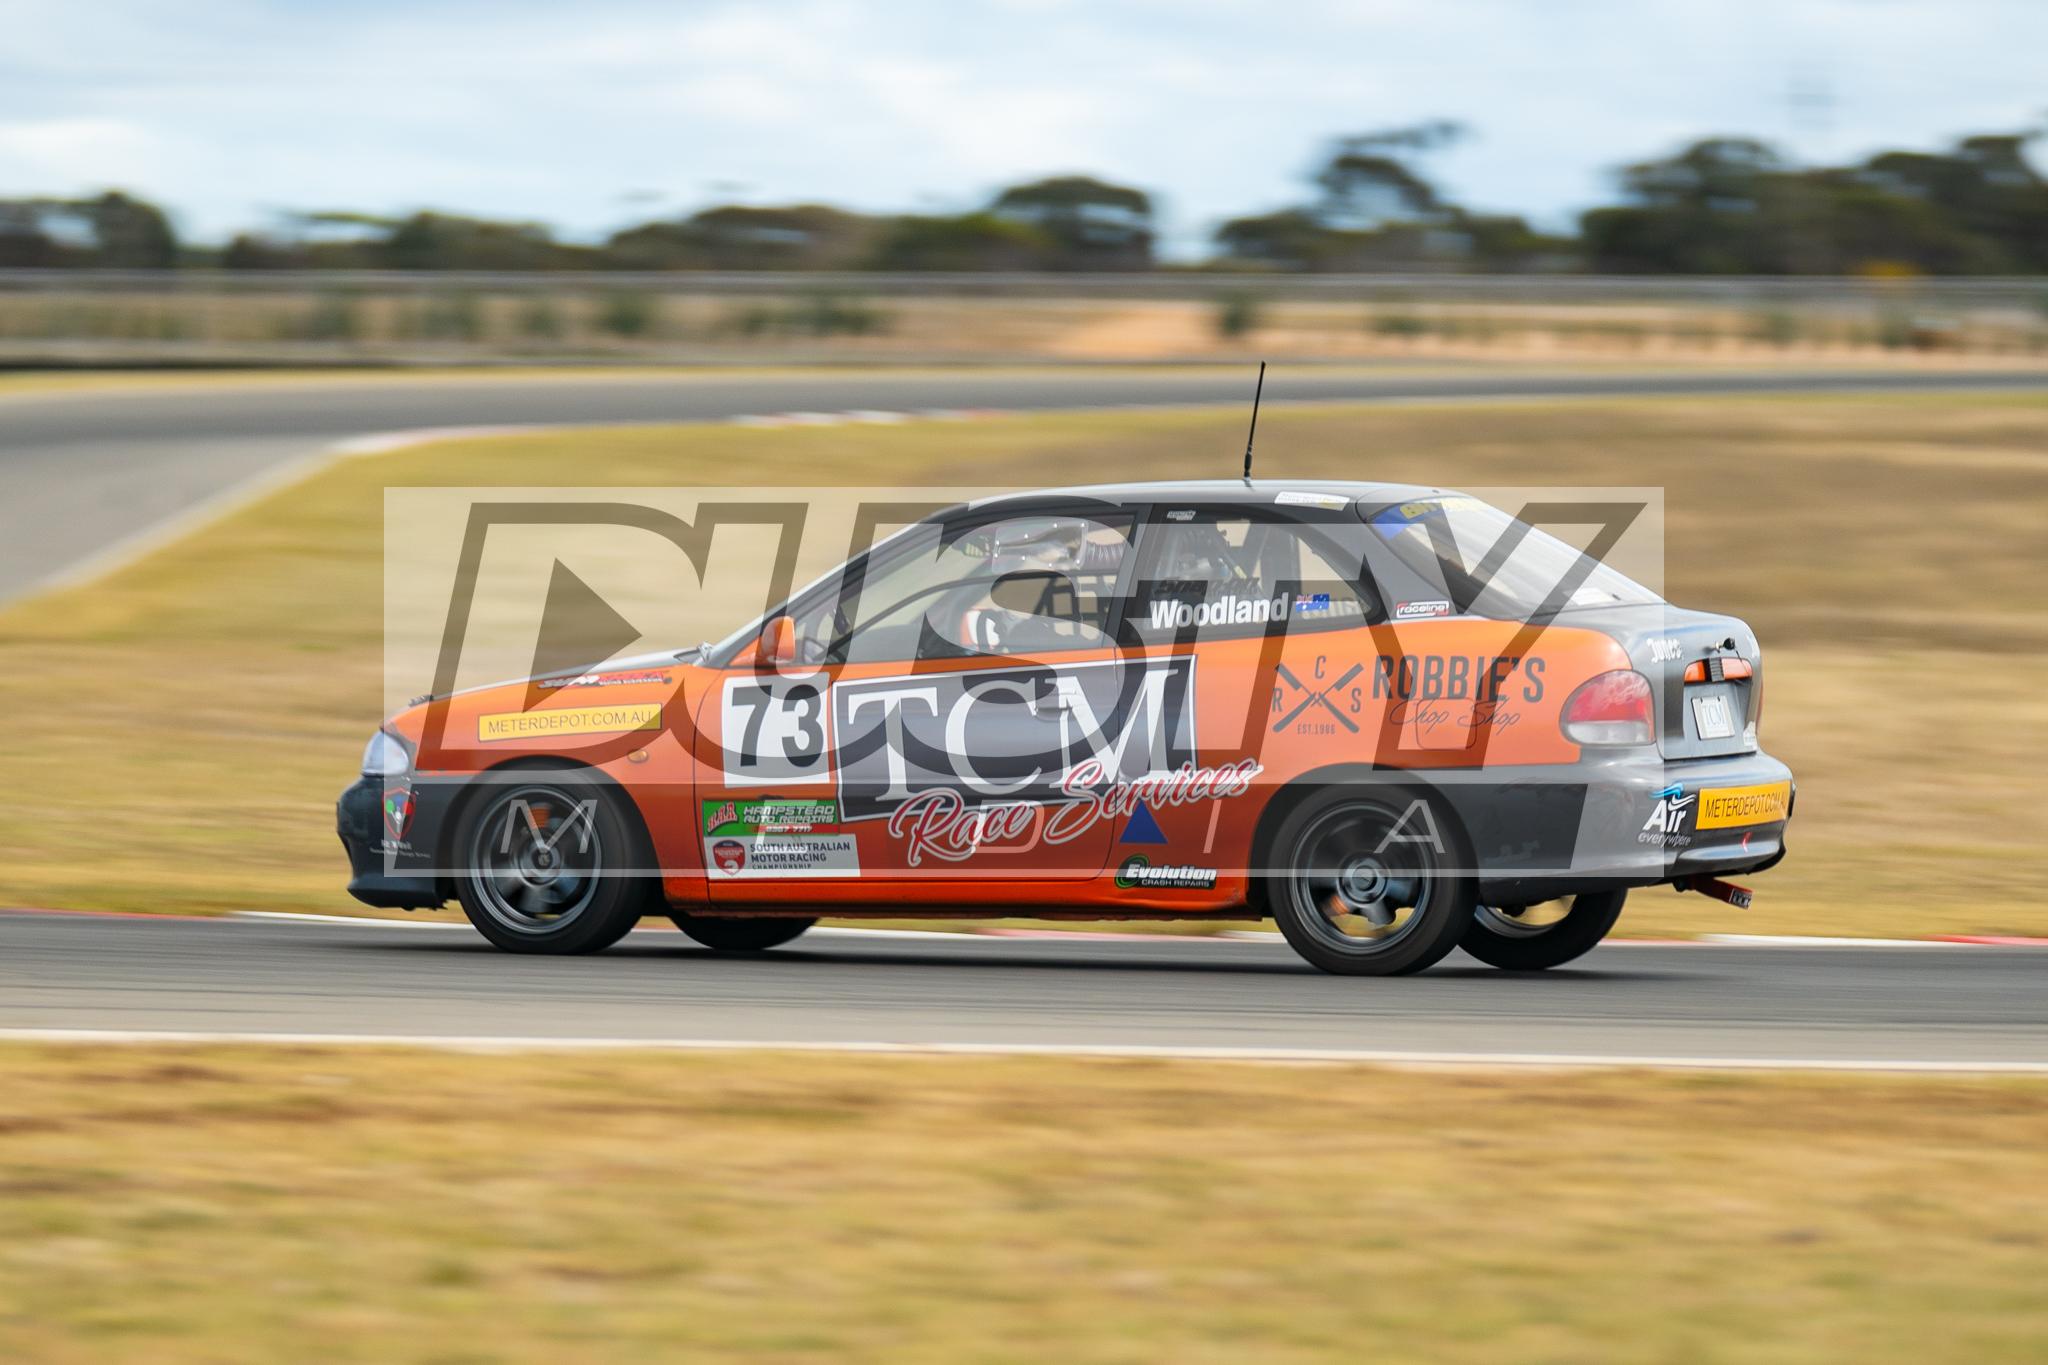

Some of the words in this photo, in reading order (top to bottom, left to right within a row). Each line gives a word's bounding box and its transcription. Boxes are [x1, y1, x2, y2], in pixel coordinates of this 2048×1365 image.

[1150, 592, 1289, 630] Woodland
[1372, 655, 1546, 704] ROBBIE'S
[487, 711, 651, 734] METERDEPOT.COM.AU
[731, 683, 824, 768] 73
[847, 668, 1192, 803] TCM
[743, 805, 835, 816] HAMPSTEAD
[888, 787, 1035, 868] Race
[1043, 757, 1265, 845] Services
[1642, 799, 1687, 833] Air
[750, 842, 788, 853] SOUTH
[787, 841, 851, 853] AUSTRALIAN
[751, 853, 787, 863] MOTOR
[789, 852, 827, 863] RACING
[1125, 862, 1217, 881] Evolution
